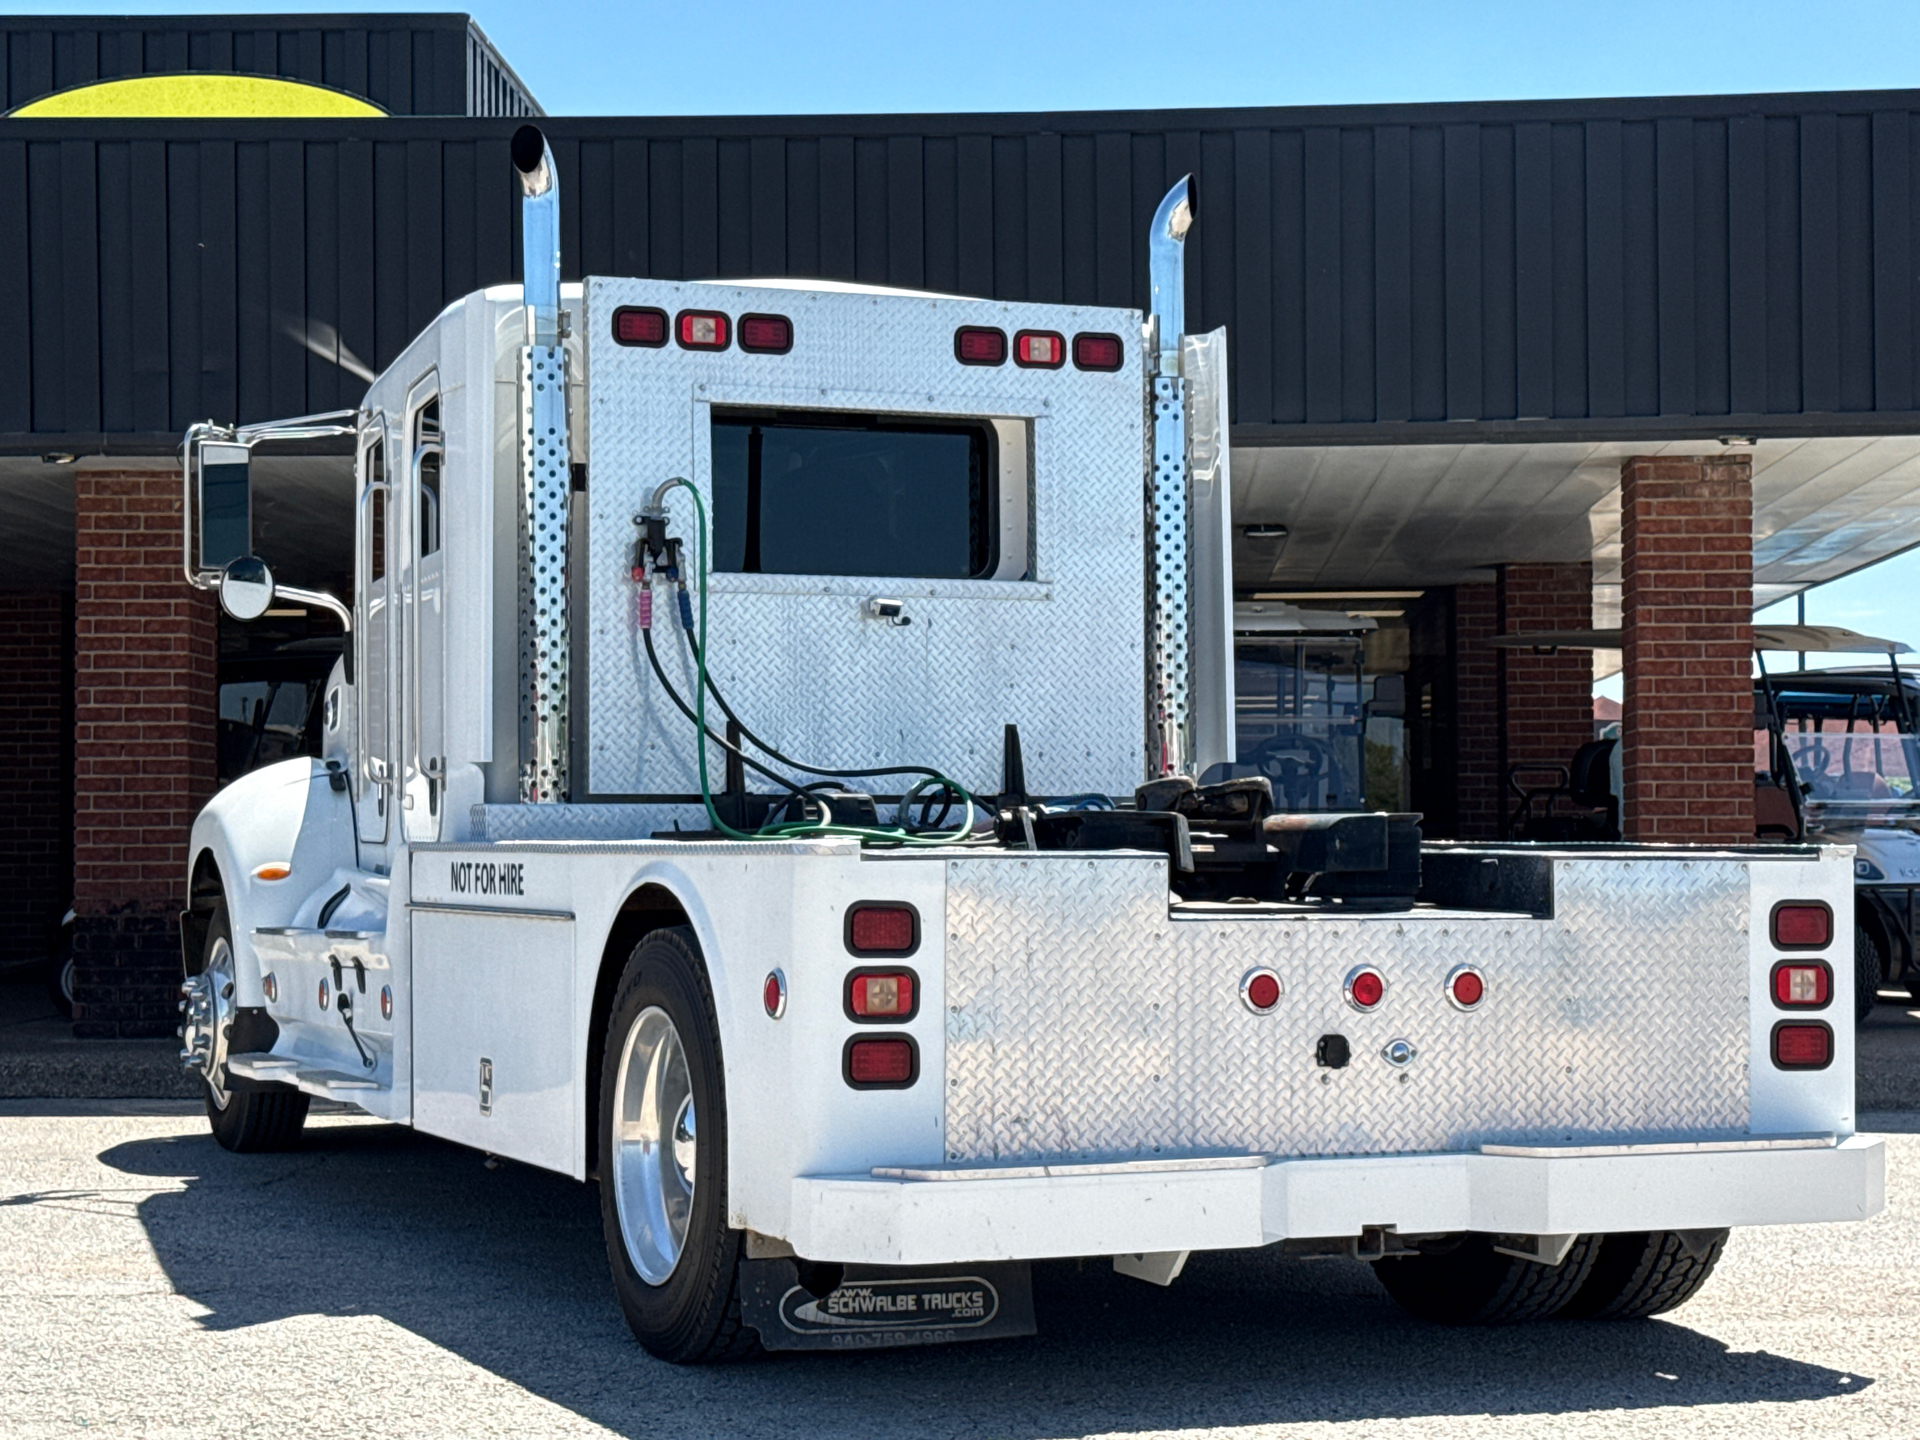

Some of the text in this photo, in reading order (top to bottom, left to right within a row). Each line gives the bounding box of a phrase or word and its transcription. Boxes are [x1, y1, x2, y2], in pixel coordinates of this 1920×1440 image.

[451, 861, 525, 896] NOT FOR HIRE
[827, 1291, 984, 1314] SCHWALBE TRUCKS
[951, 1306, 985, 1318] .com
